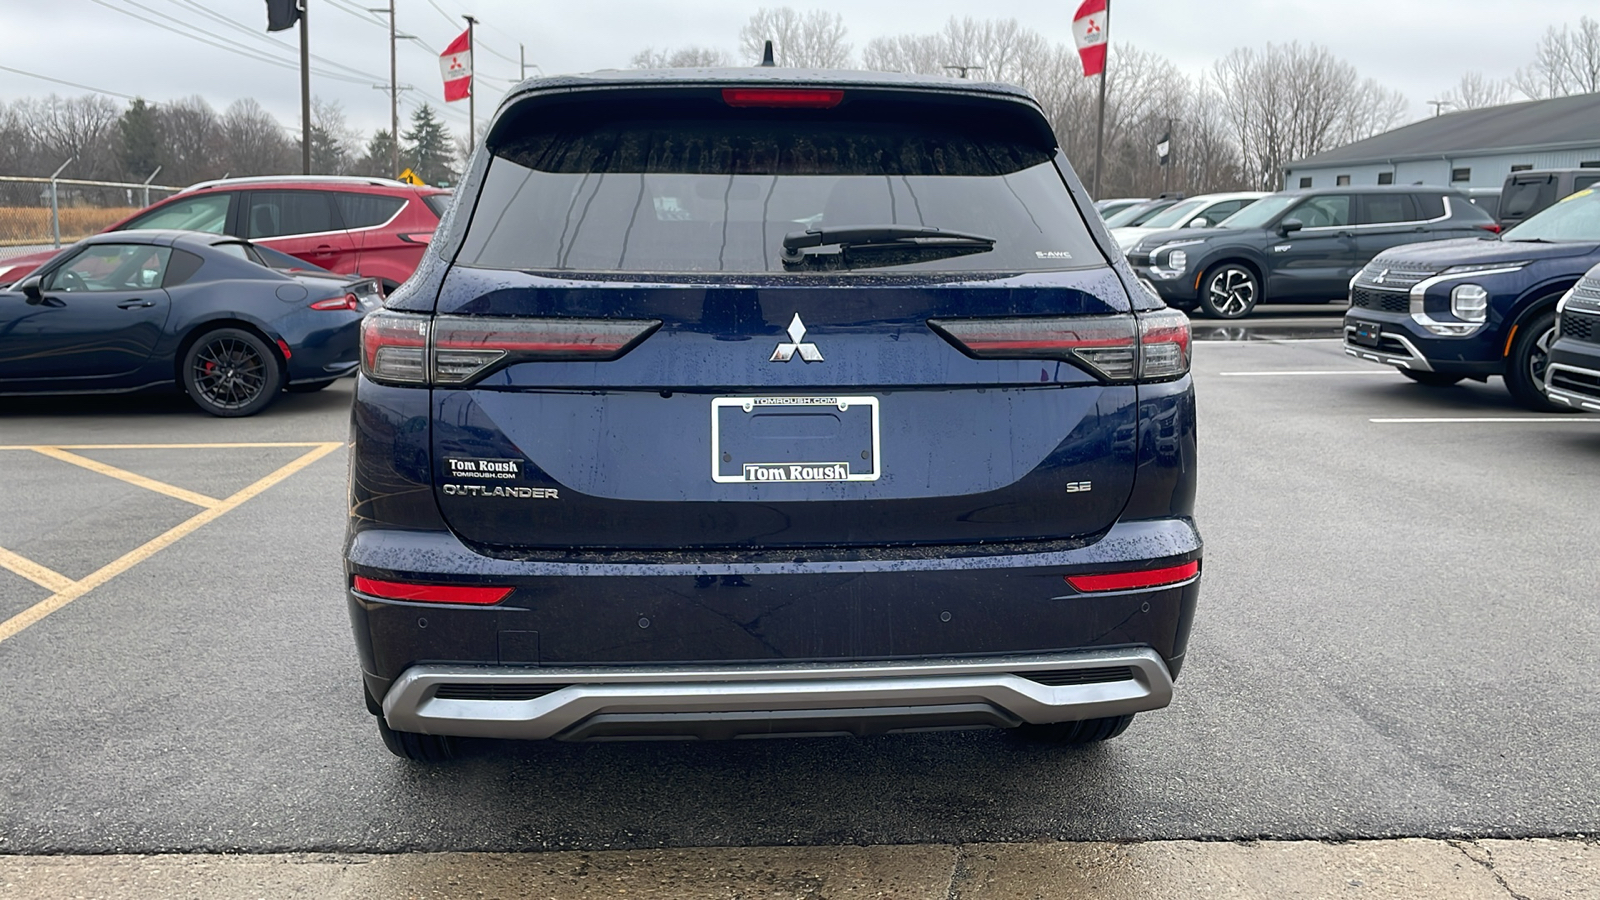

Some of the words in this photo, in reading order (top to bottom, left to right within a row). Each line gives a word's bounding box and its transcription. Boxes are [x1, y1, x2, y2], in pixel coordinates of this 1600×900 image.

[753, 397, 838, 405] TOMROUSH.COM
[449, 459, 476, 471] Tom
[479, 460, 518, 472] Roush
[452, 471, 516, 479] TOMROUSH.COM
[745, 465, 786, 480] Tom
[789, 464, 847, 480] Roush
[442, 483, 559, 499] OUTLANDER
[1066, 481, 1092, 493] SE
